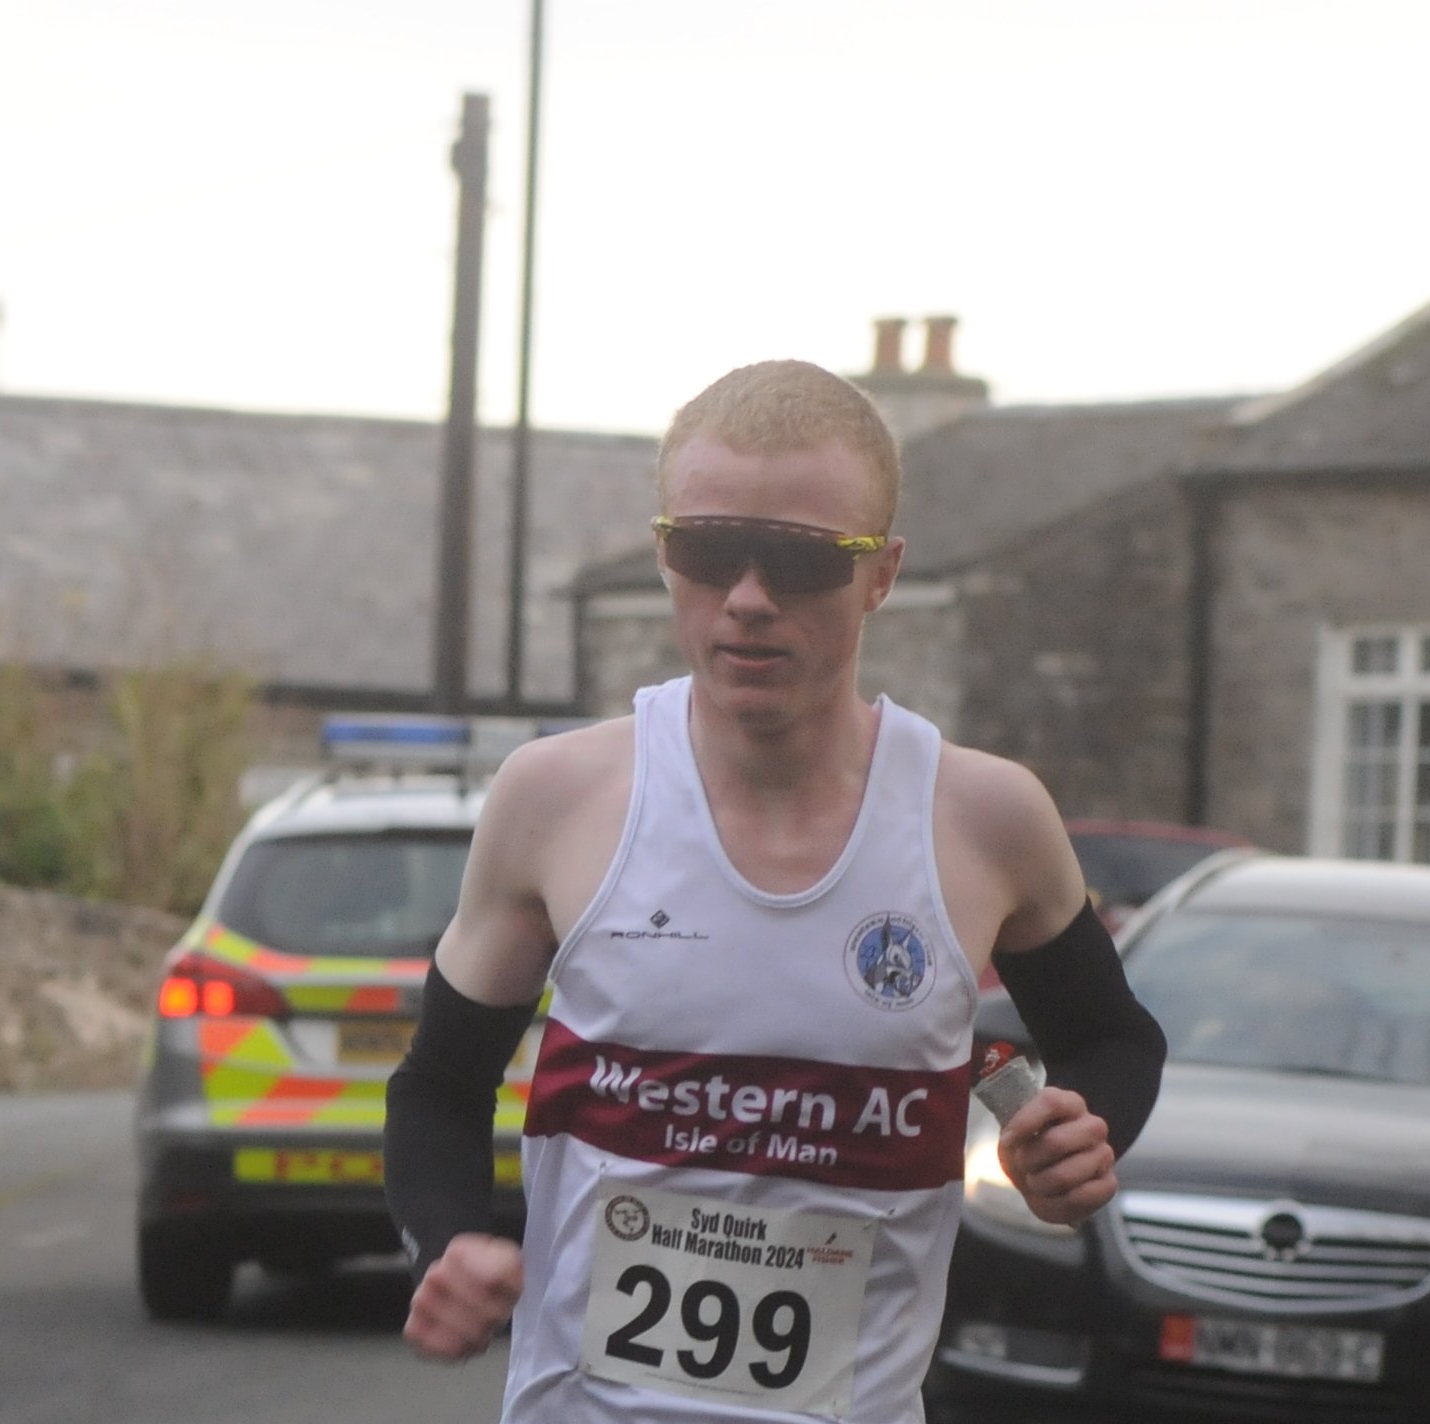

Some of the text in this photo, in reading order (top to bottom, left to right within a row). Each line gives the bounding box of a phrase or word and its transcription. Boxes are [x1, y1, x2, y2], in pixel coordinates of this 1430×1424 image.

[611, 931, 709, 940] RONHILL
[589, 1054, 929, 1138] Western AC
[664, 1123, 838, 1167] Isle of Man
[692, 1208, 767, 1240] Syd Quirk
[652, 1225, 805, 1269] Half Marathon 2024
[605, 1265, 811, 1389] 299
